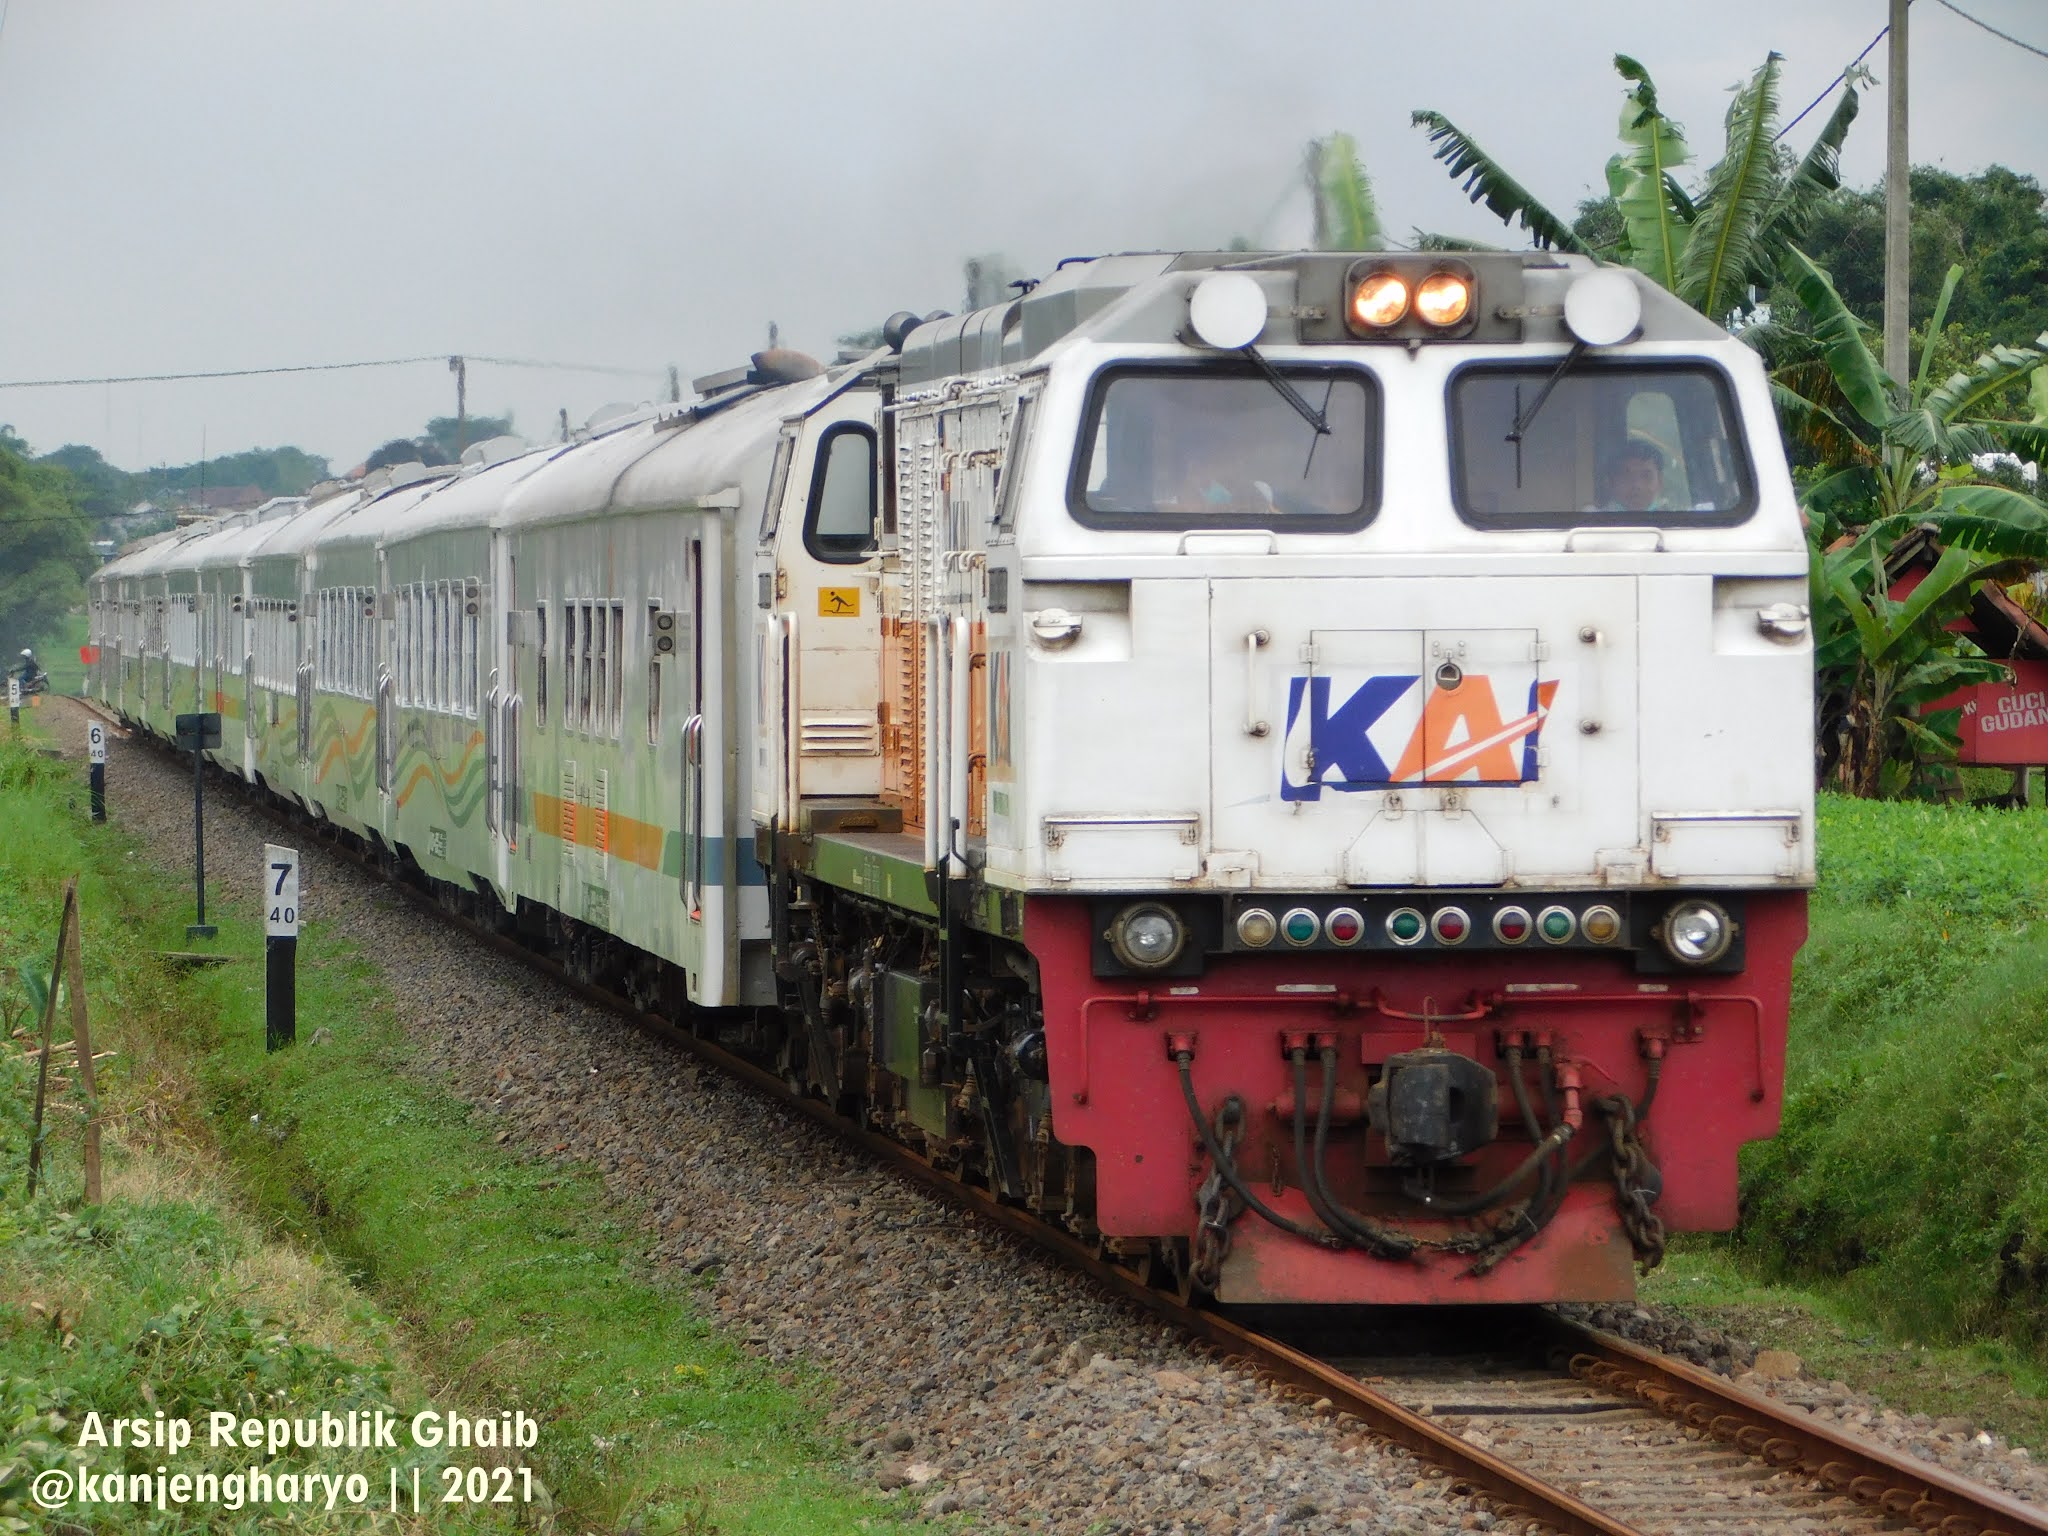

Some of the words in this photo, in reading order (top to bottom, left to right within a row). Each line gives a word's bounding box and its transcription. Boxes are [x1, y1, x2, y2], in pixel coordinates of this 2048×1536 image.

[1997, 691, 2046, 713] CUCI
[90, 727, 101, 744] 6
[1280, 674, 1560, 801] KAI
[90, 749, 104, 758] 40
[271, 863, 292, 895] 7
[269, 906, 295, 924] 40
